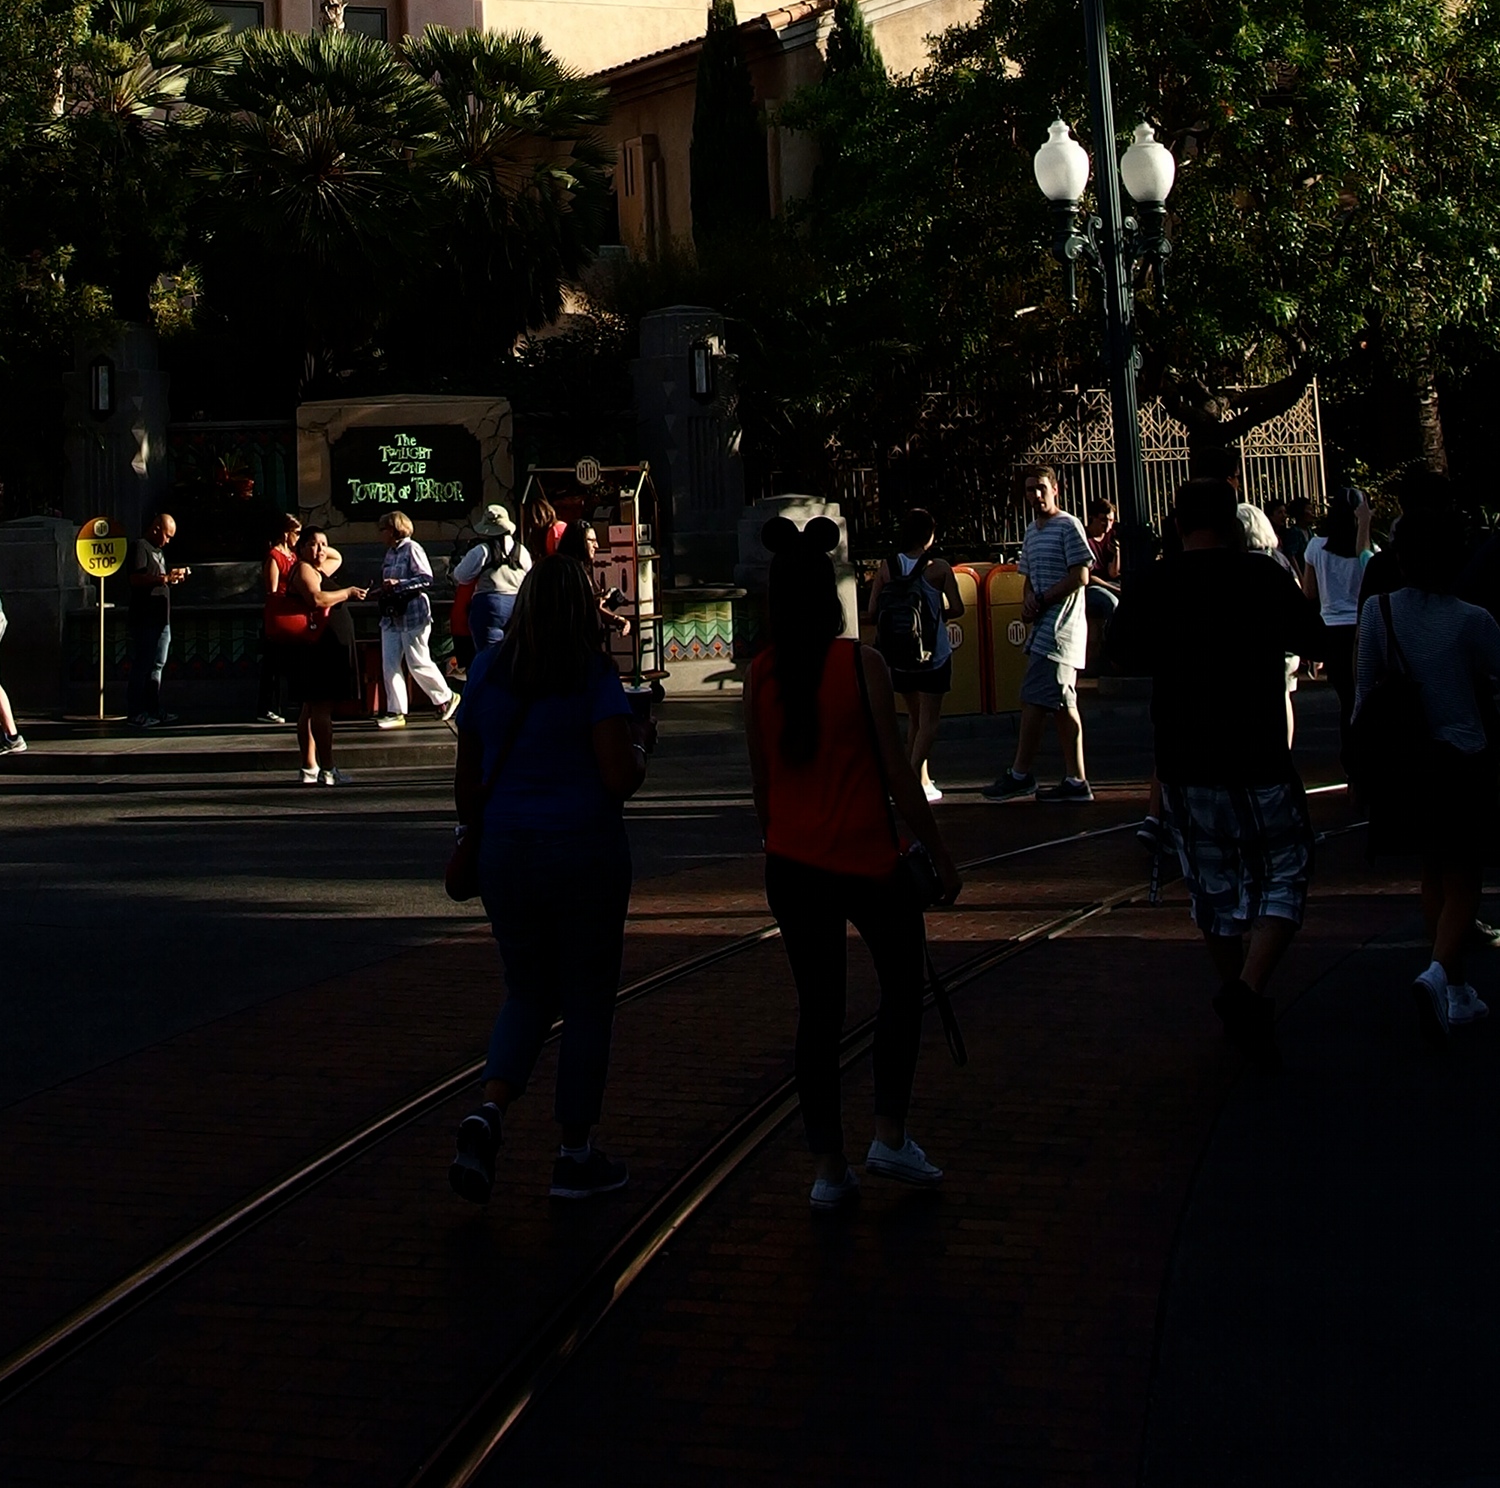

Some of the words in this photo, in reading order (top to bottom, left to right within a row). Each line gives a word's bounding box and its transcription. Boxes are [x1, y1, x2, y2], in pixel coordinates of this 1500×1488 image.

[394, 433, 417, 446] The
[91, 543, 114, 555] TAXI
[89, 557, 117, 569] STOP
